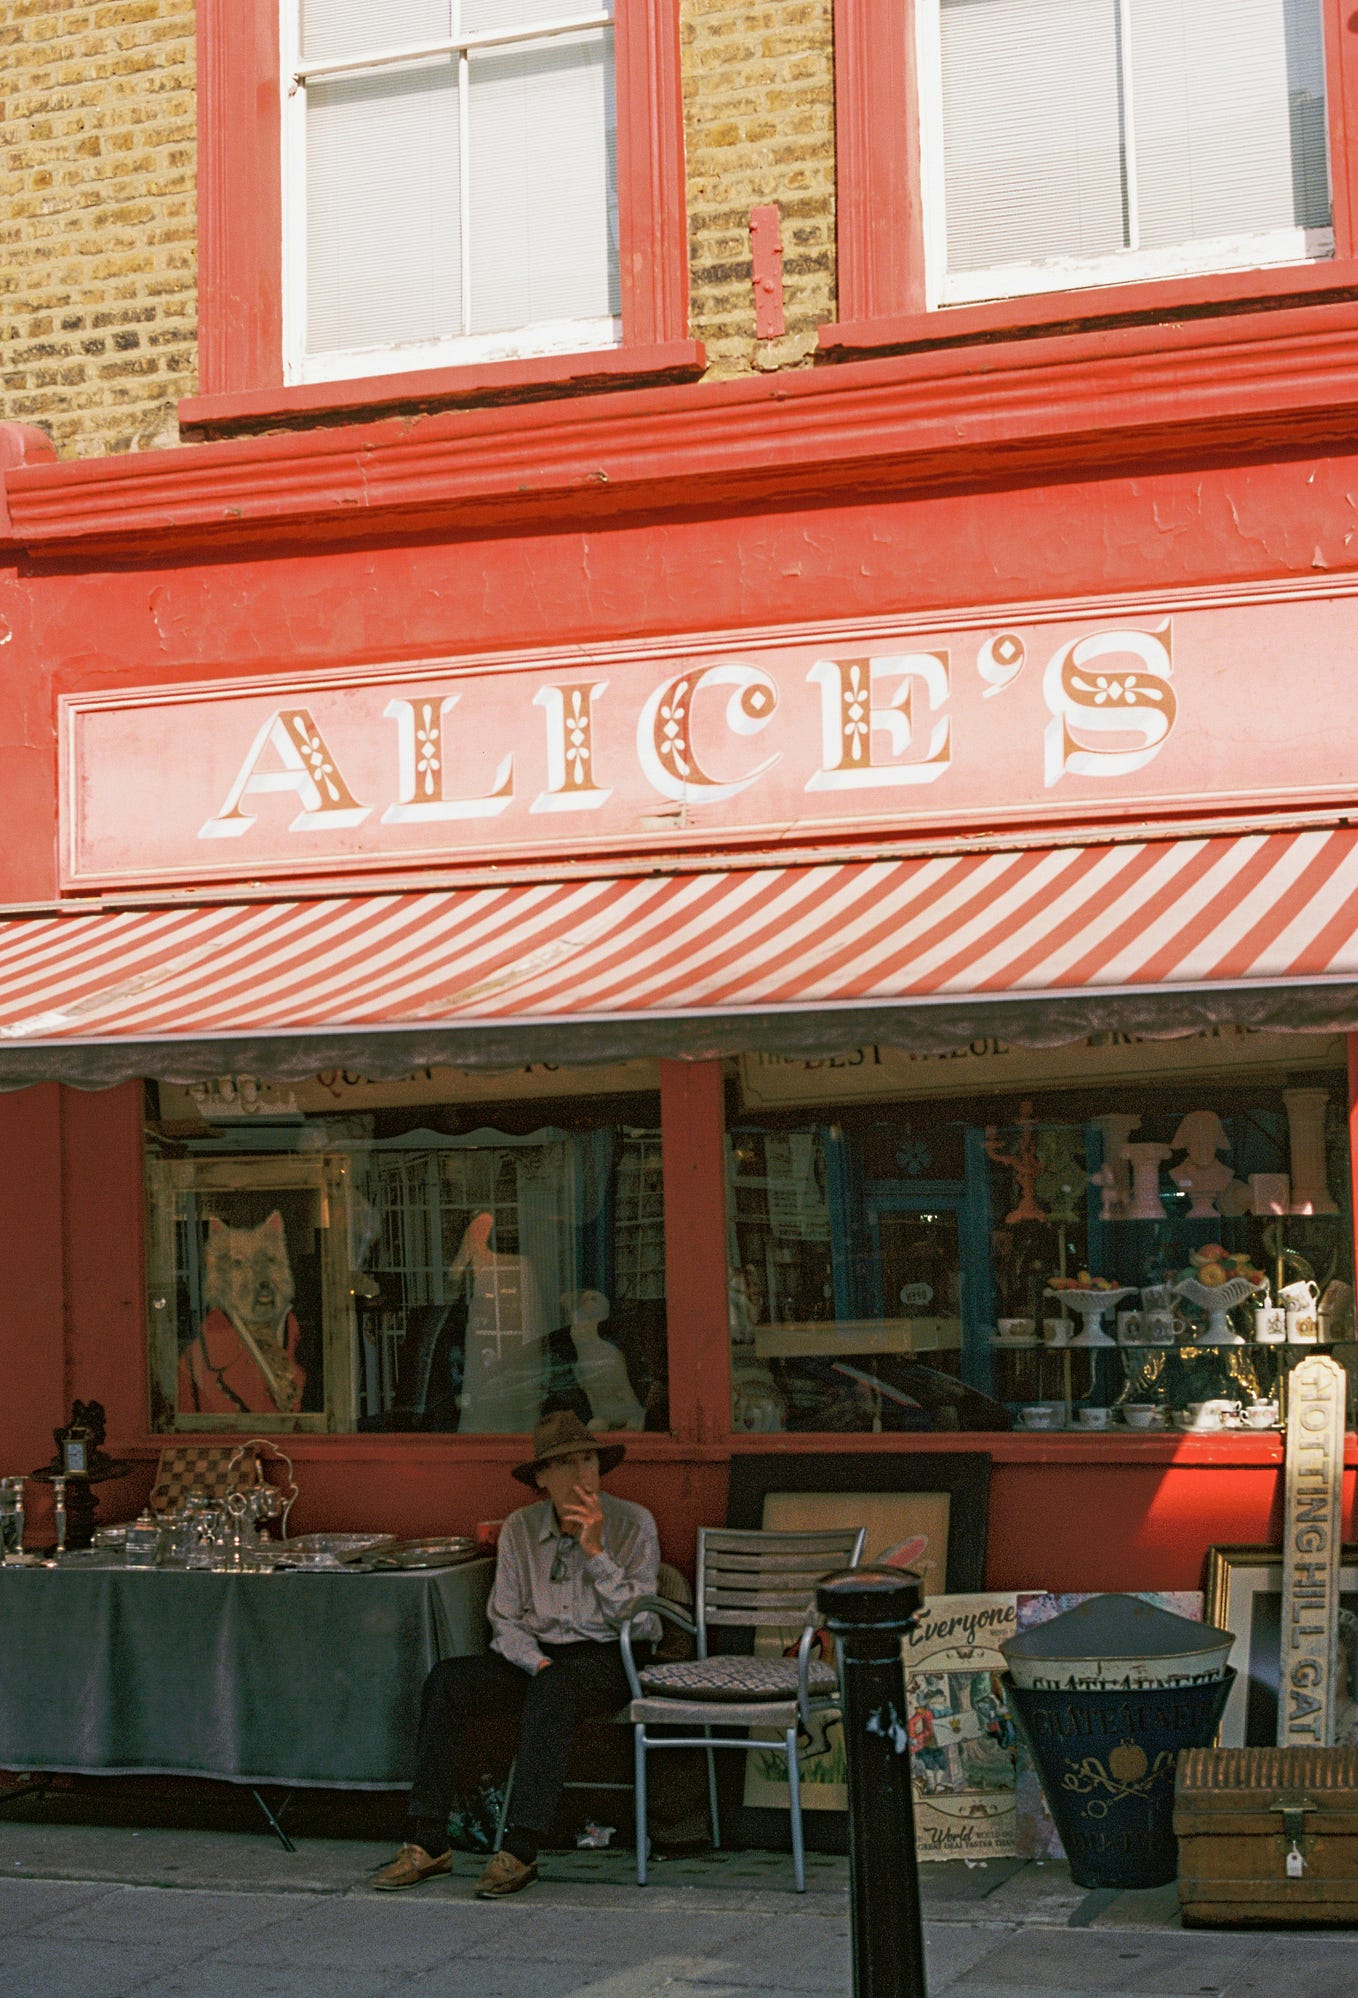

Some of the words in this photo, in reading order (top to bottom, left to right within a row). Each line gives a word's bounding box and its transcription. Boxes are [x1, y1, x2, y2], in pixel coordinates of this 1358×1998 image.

[197, 616, 1178, 839] ALICE'S
[1295, 1374, 1333, 1553] NOTTING
[909, 1605, 1017, 1647] Everyone
[1292, 1561, 1328, 1650] HILL
[923, 1825, 974, 1842] World
